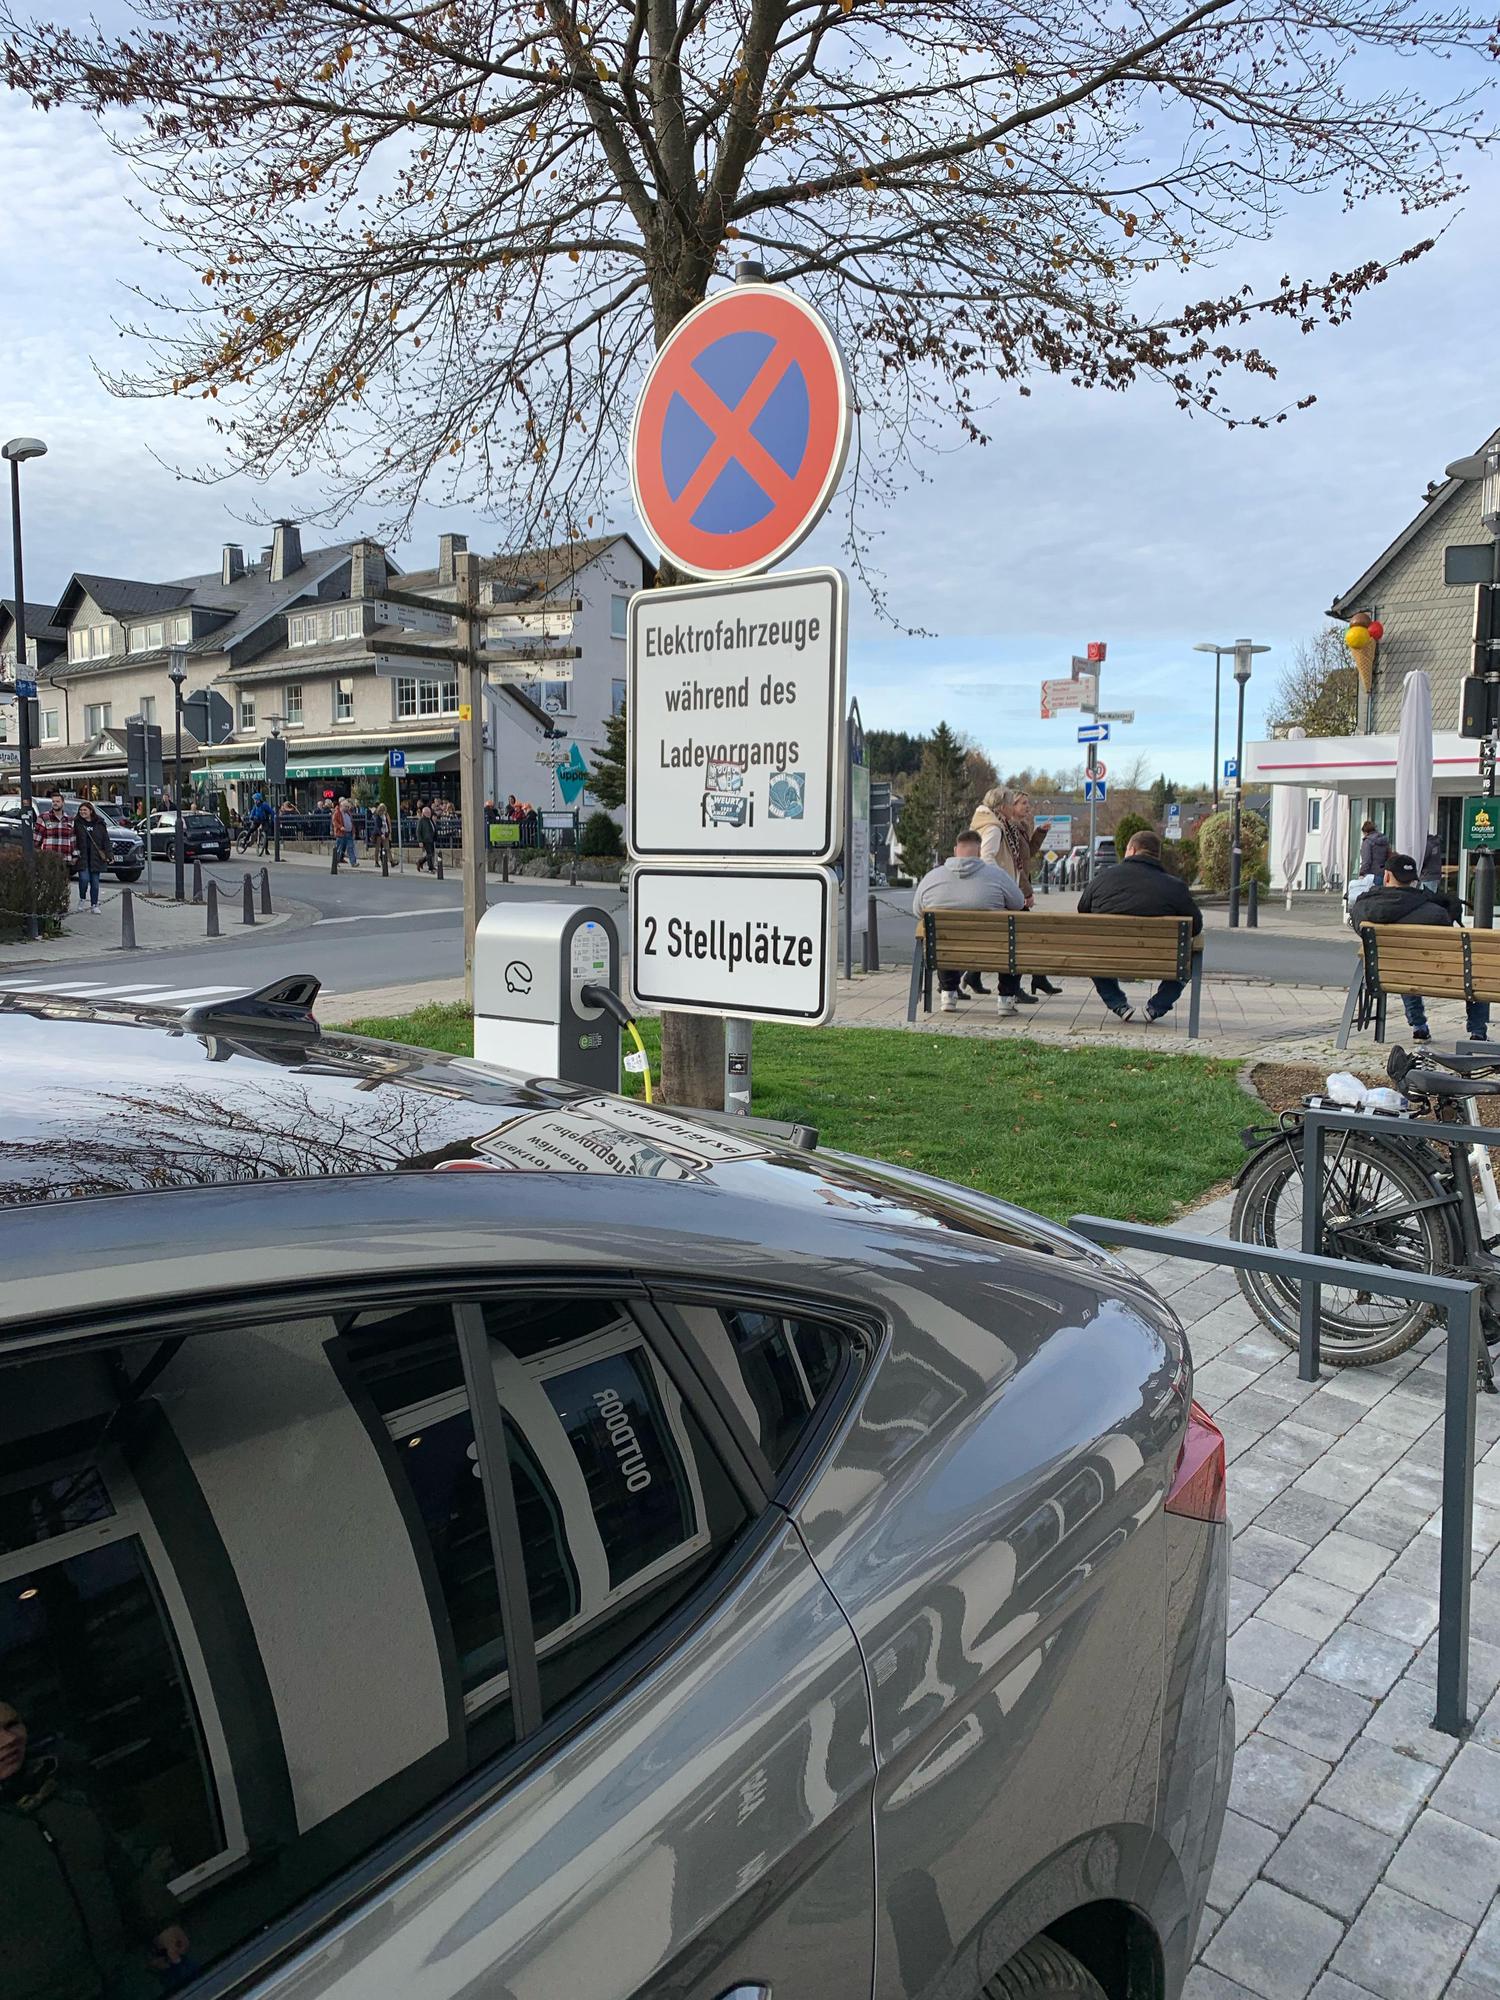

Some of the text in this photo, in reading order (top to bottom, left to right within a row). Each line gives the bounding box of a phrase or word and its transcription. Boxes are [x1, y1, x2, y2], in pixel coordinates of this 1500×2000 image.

[645, 616, 820, 658] Elektrofahrzeuge
[665, 674, 797, 712] während des
[392, 753, 402, 765] P
[660, 738, 799, 773] Ladevorgangs
[1227, 762, 1236, 776] P
[701, 791, 754, 827] fi
[644, 916, 657, 956] 2
[667, 917, 813, 973] Stellplätze
